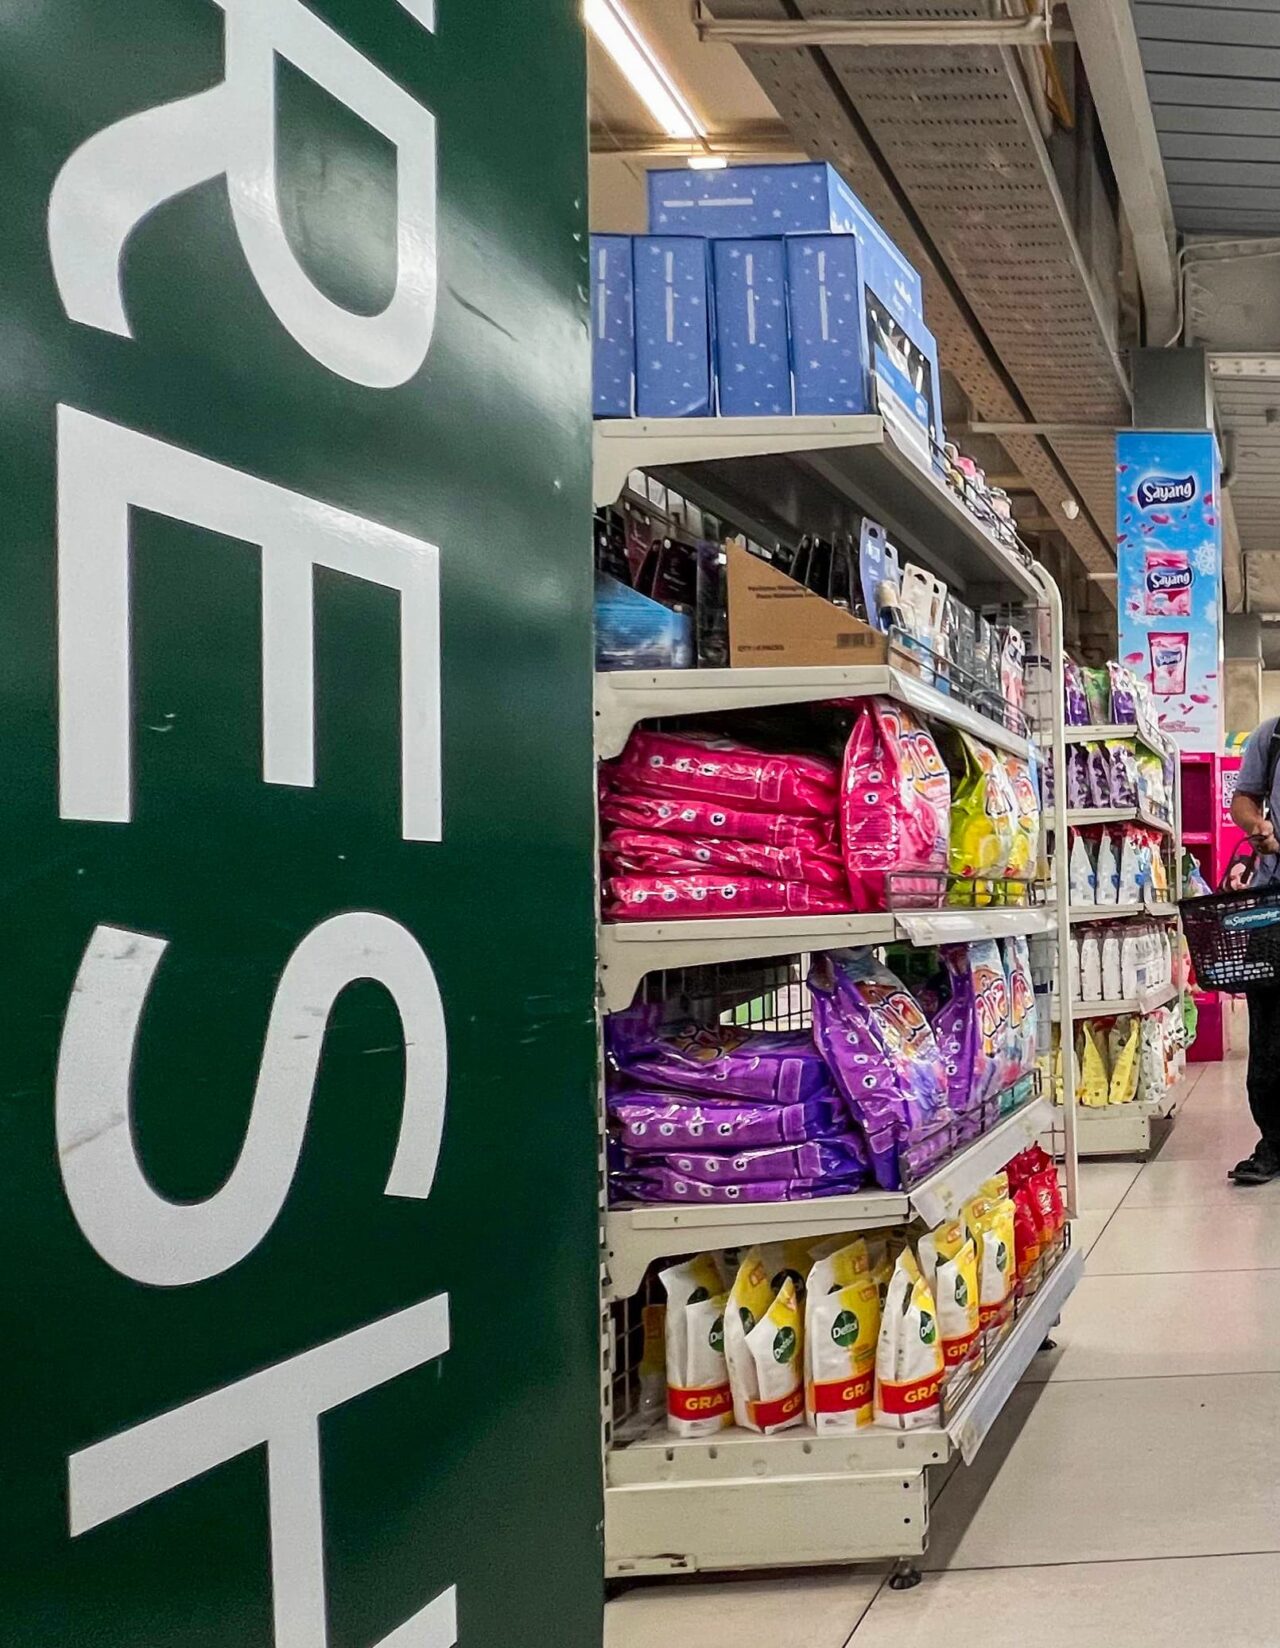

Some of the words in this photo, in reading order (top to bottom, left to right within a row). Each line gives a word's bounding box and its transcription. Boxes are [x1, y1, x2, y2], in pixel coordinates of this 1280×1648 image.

[1142, 482, 1192, 503] Sayang
[1150, 571, 1190, 589] Sayang
[46, 0, 457, 1648] RESH
[832, 1319, 859, 1340] Dettol
